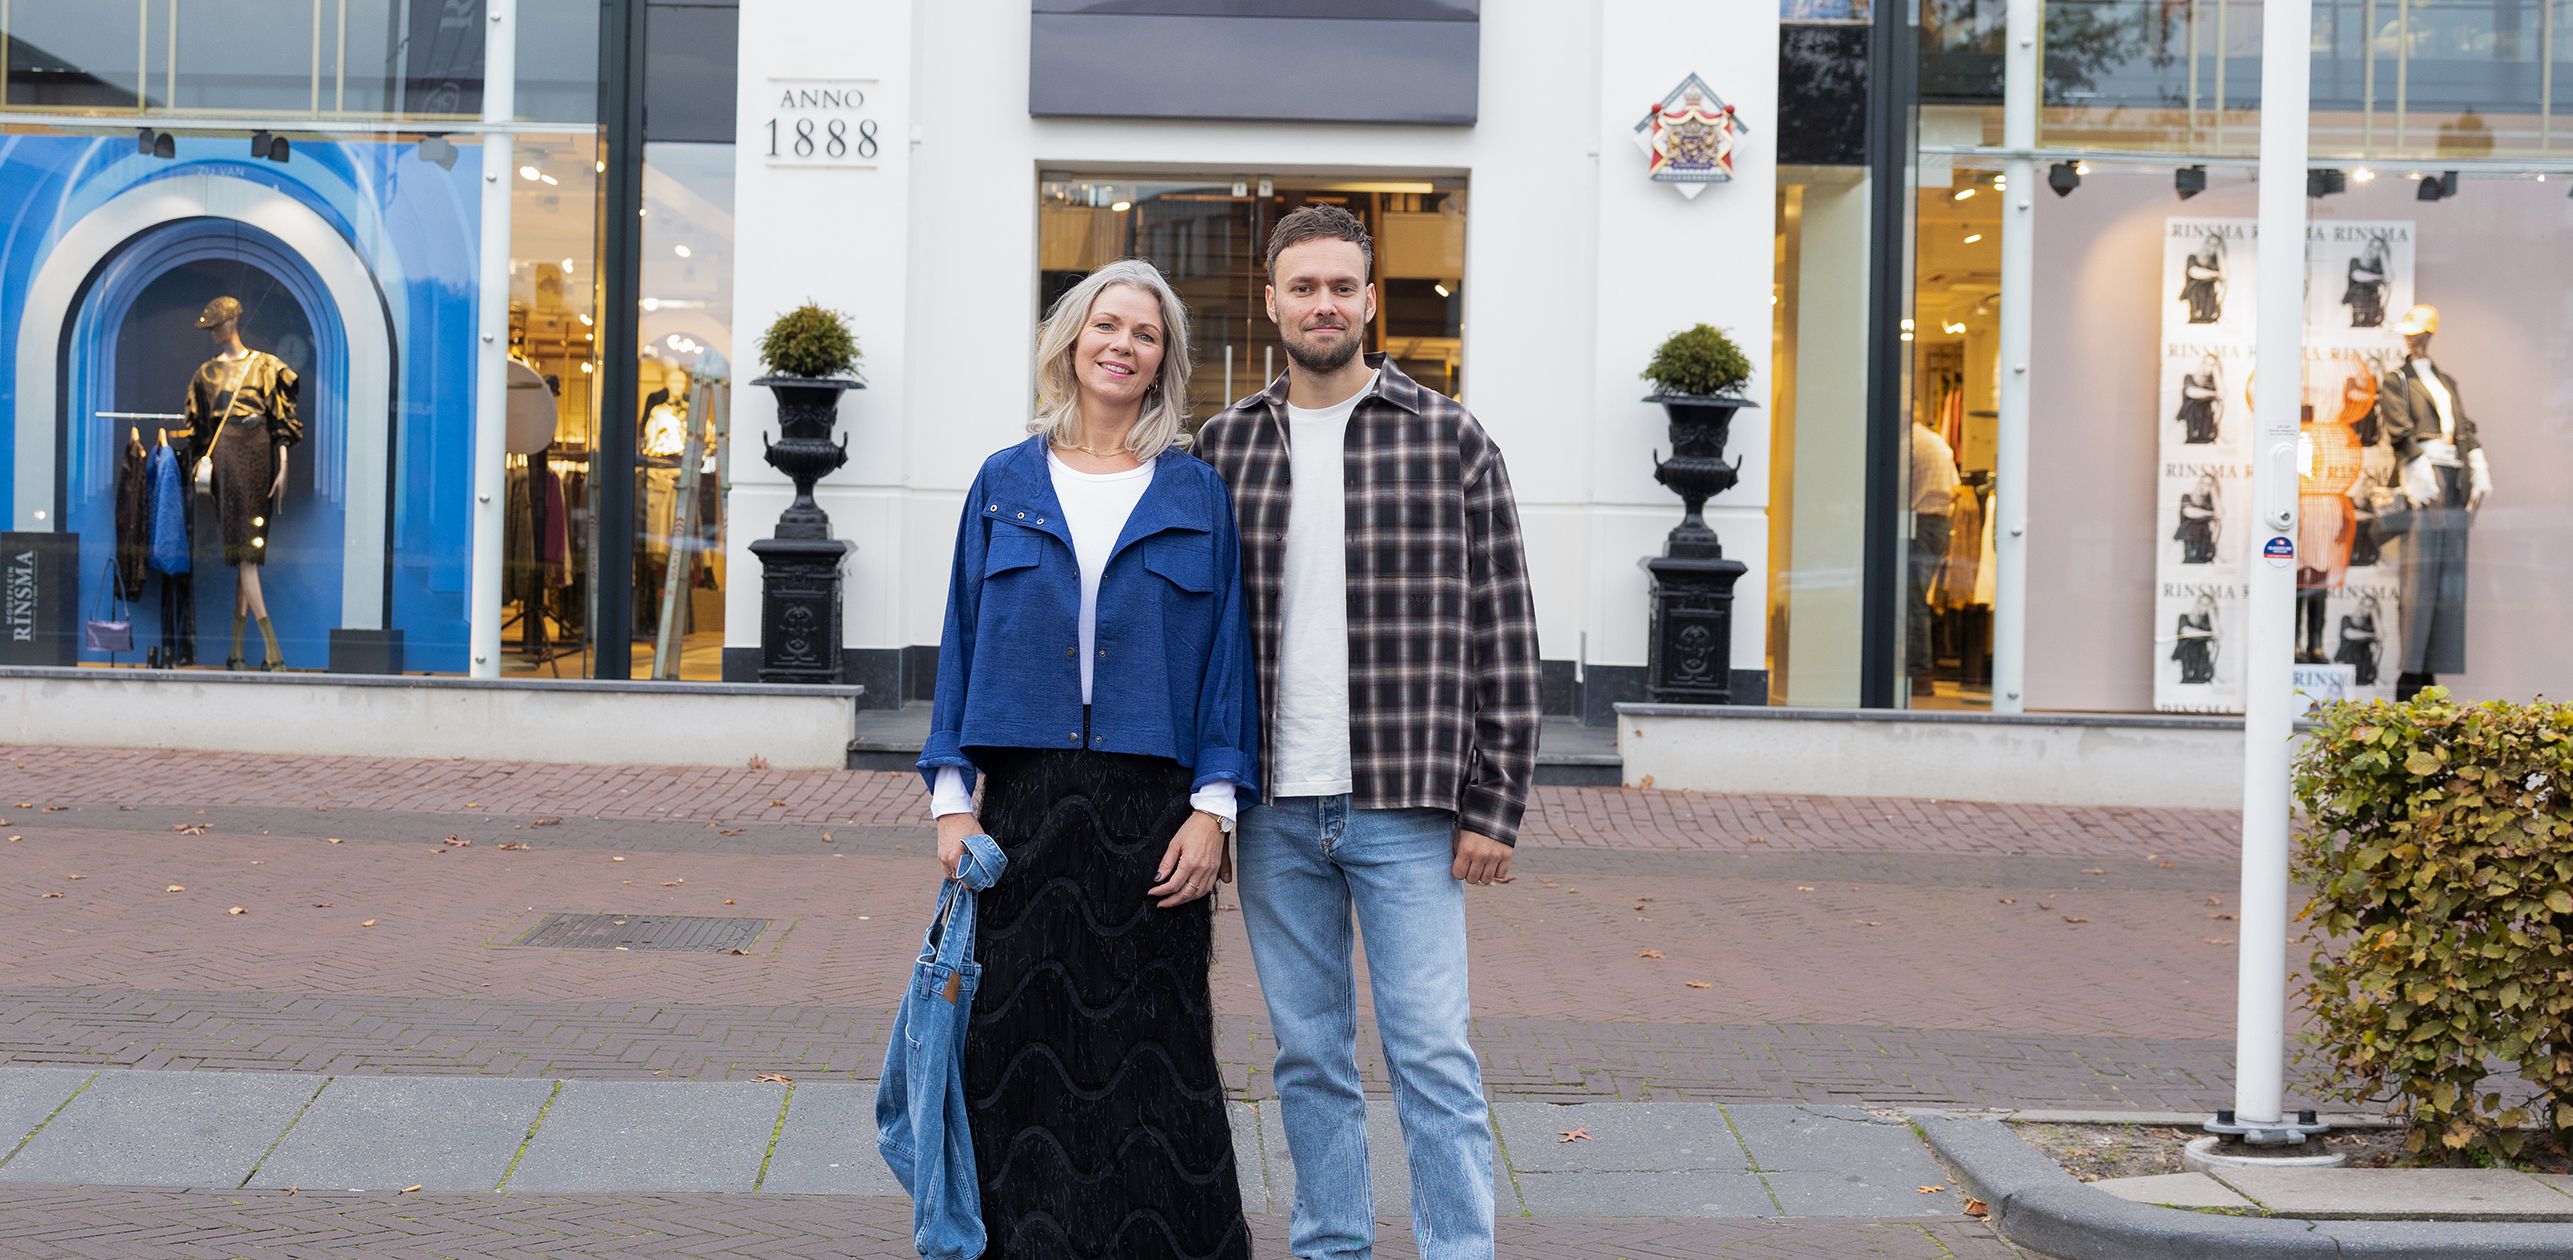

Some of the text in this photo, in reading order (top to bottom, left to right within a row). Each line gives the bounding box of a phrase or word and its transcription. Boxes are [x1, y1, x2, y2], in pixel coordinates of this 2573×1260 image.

[780, 89, 864, 109] ANNO
[765, 118, 878, 159] 1888
[13, 550, 33, 642] RINSMA
